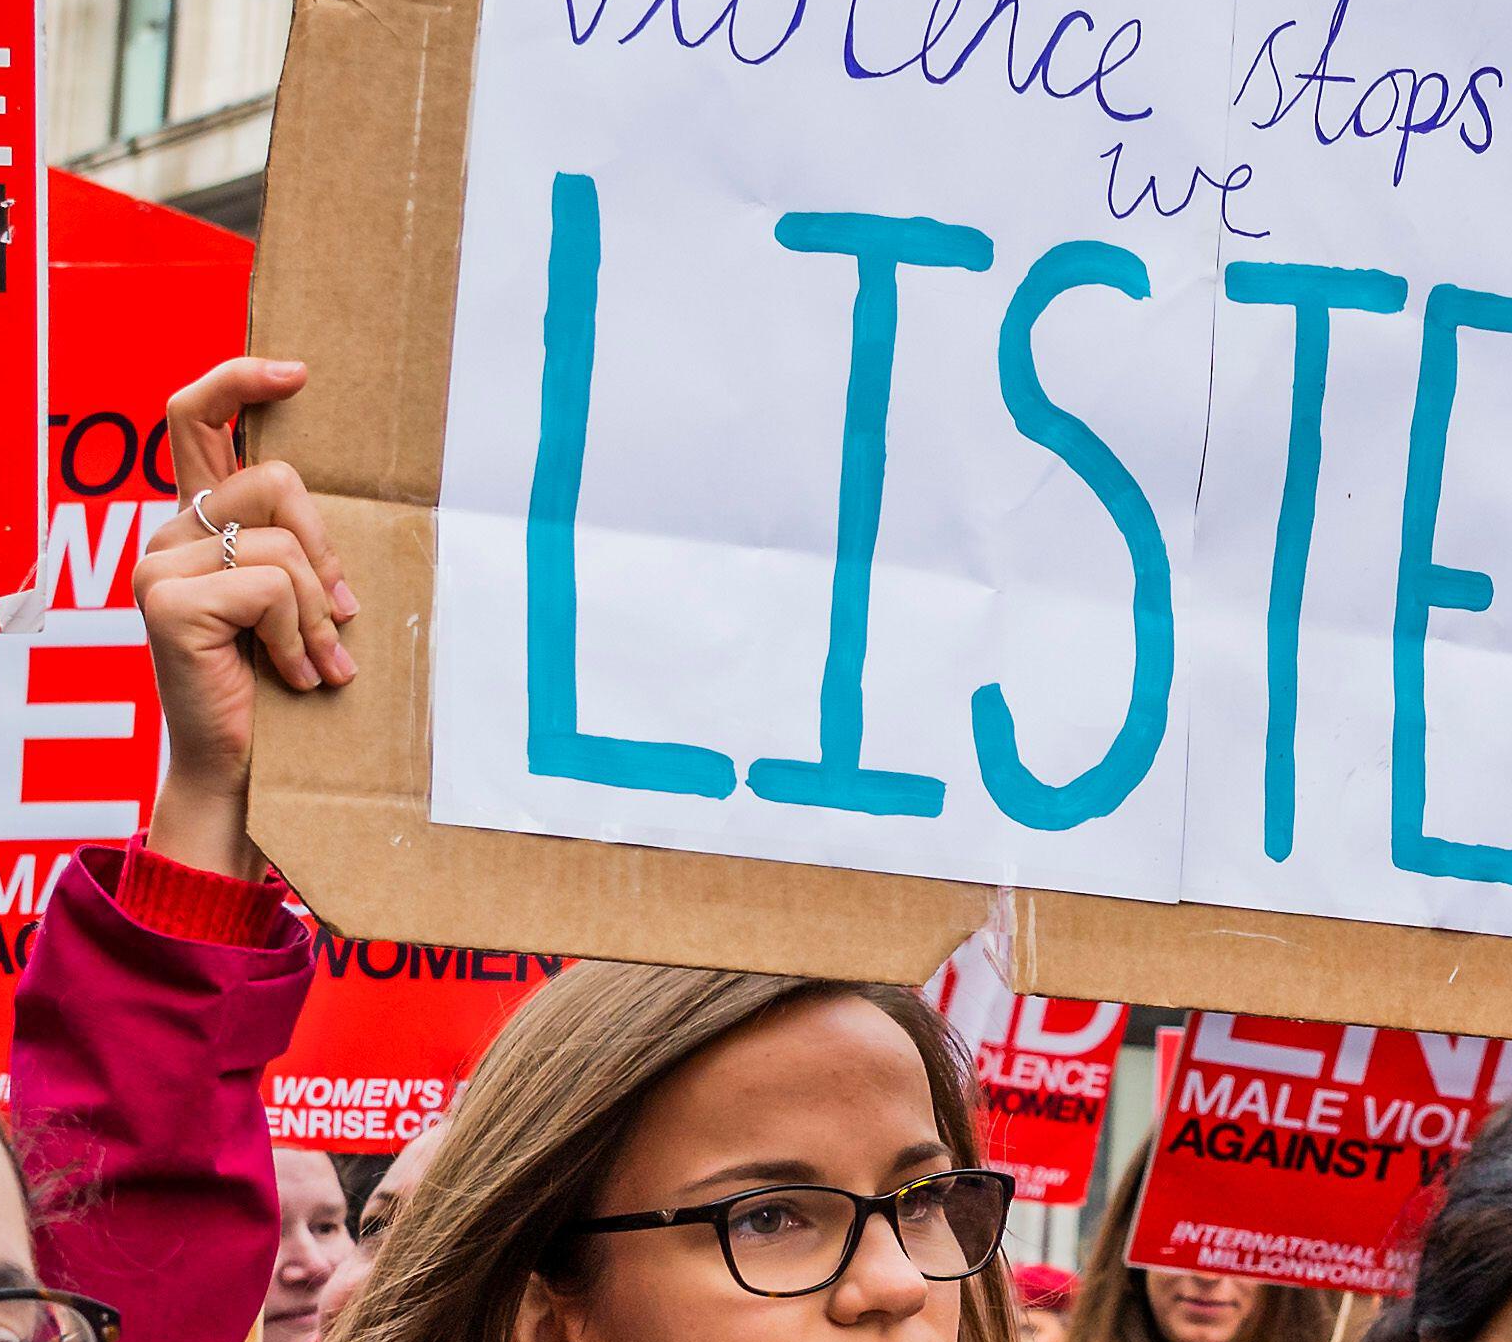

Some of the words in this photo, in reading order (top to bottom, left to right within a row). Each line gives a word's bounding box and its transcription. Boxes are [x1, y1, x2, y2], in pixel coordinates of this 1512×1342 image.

[1100, 143, 1270, 241] we
[274, 1076, 445, 1109] WOMEN'S
[1177, 1069, 1356, 1135] MALE
[1167, 1119, 1405, 1181] AGAINST
[1170, 1220, 1377, 1268] INTERNATIONAL
